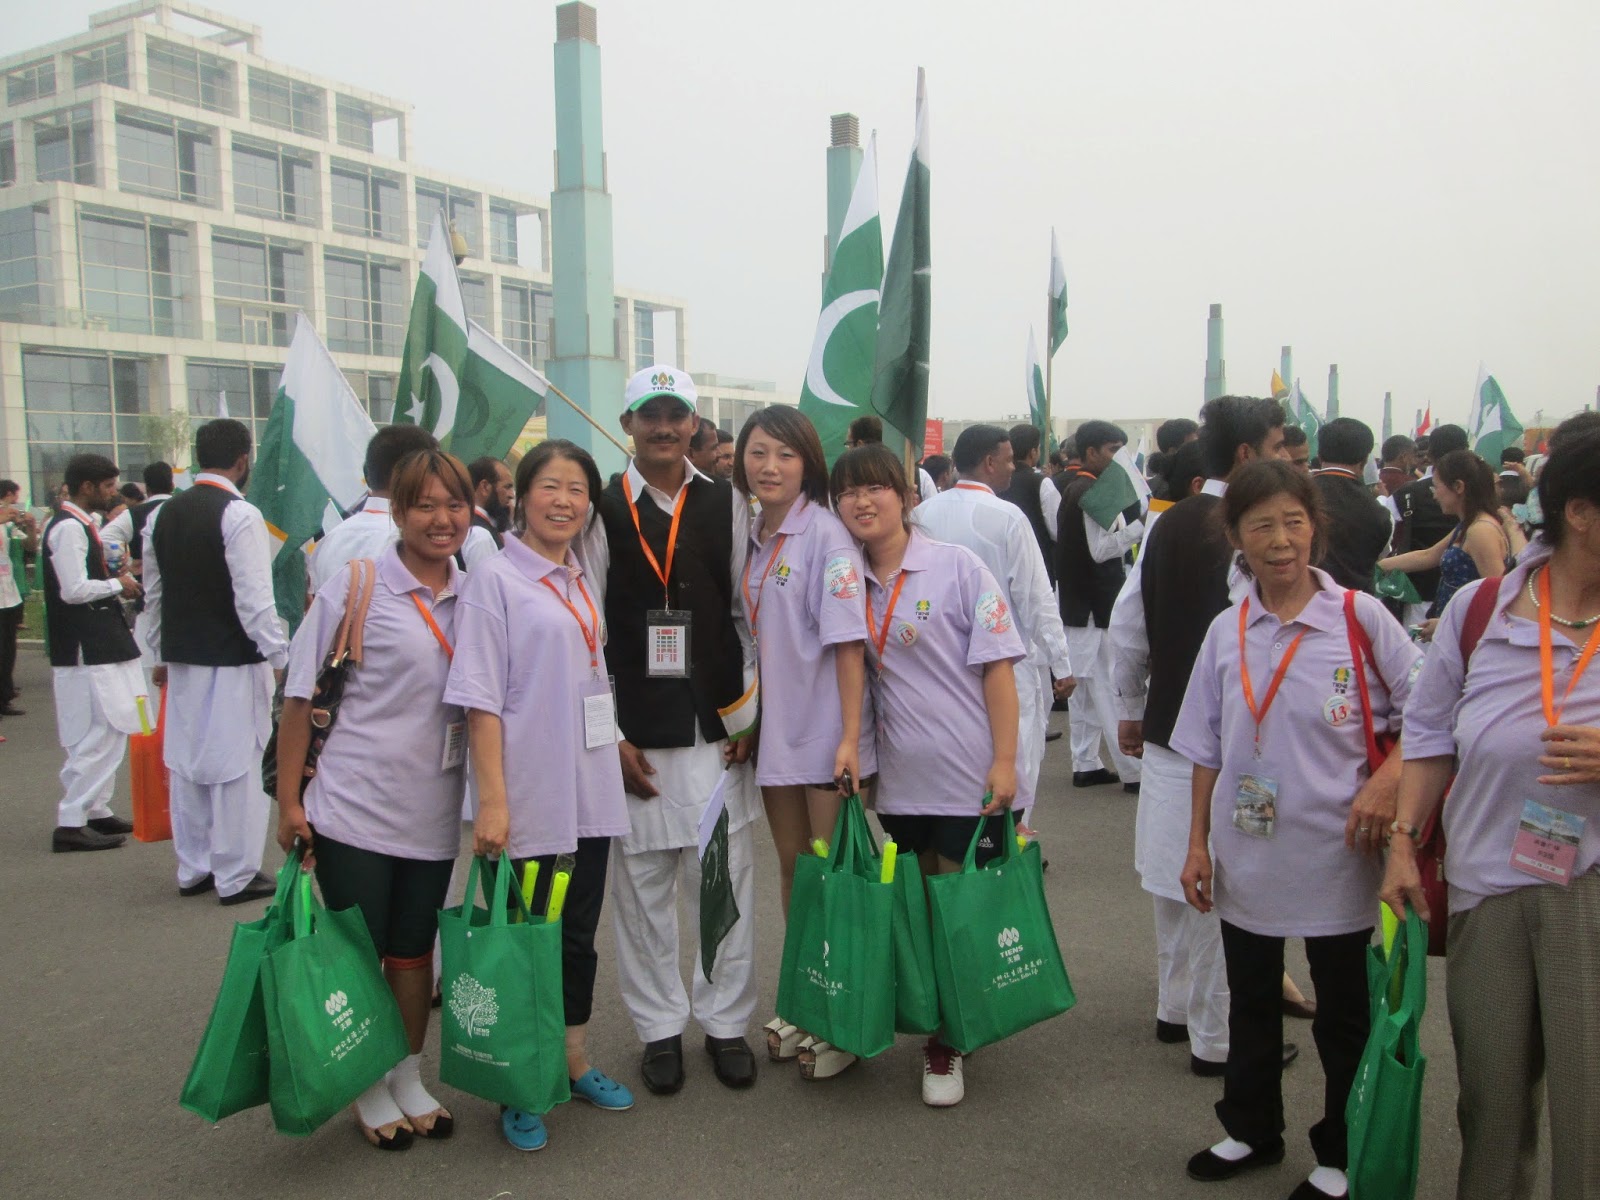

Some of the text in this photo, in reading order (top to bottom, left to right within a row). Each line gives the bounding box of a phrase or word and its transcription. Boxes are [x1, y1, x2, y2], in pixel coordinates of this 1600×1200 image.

[900, 629, 914, 644] 13
[1330, 705, 1347, 722] 13
[1000, 945, 1023, 958] TIENS
[332, 1007, 354, 1027] TIENS
